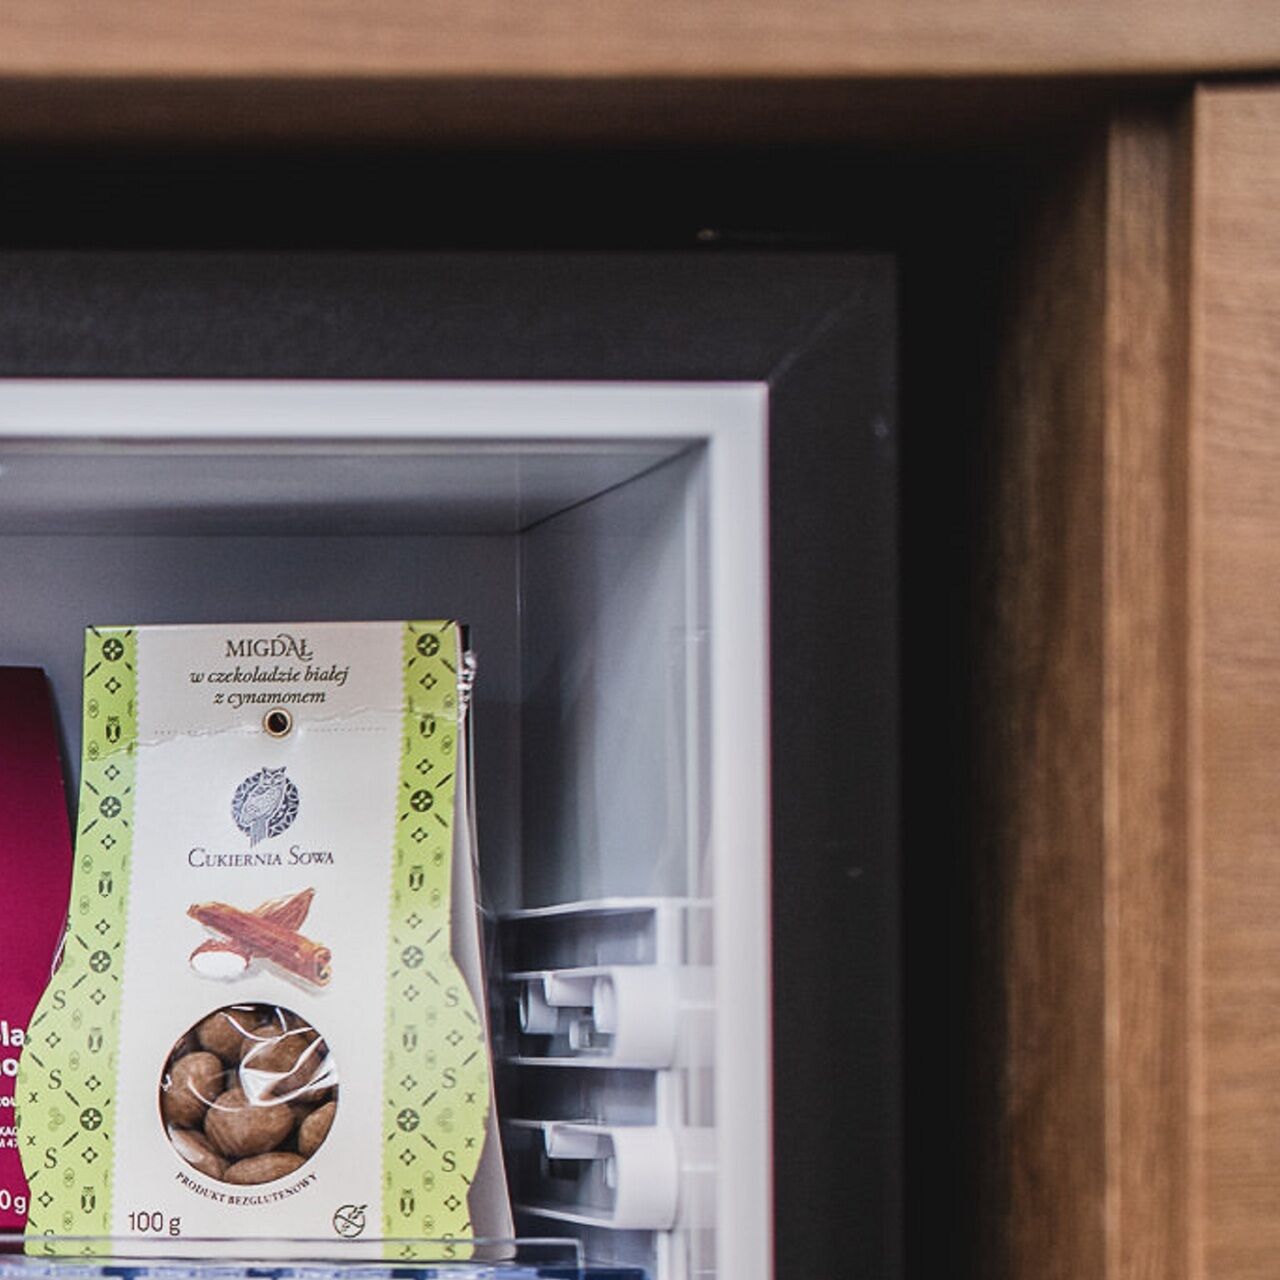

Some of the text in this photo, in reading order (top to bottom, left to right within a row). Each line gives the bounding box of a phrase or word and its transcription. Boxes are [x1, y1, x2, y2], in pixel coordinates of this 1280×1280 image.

[225, 633, 314, 662] MIGDAŁ
[190, 664, 350, 687] w czekoladzie białej
[213, 690, 326, 709] z cynamonem
[188, 844, 335, 868] CUKIERNIA SOWA
[176, 1171, 319, 1206] PRODUKT BEZGLUTENOWY
[13, 1196, 27, 1214] g
[127, 1211, 182, 1237] 100 g
